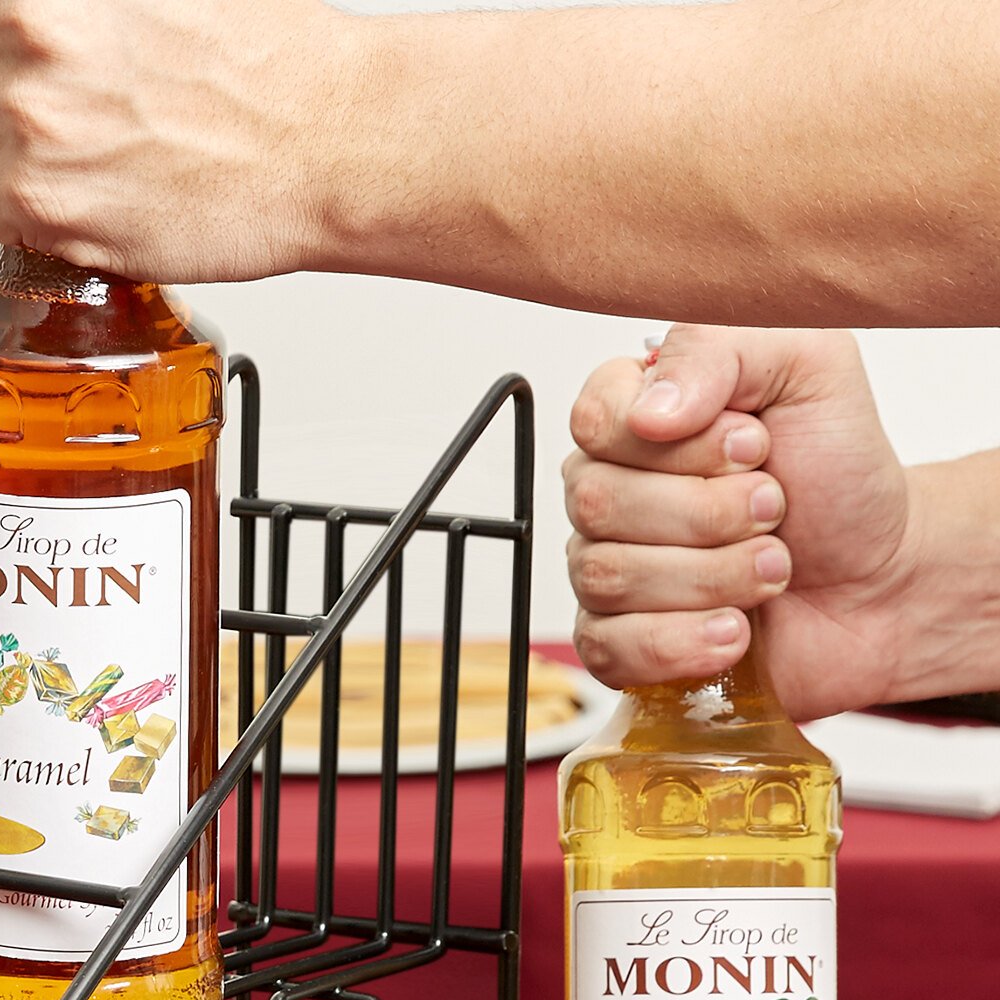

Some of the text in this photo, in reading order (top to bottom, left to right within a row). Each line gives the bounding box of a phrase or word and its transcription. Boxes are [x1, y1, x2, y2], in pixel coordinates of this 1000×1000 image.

[82, 533, 118, 555] de
[157, 916, 173, 931] oz
[626, 909, 798, 953] Le Sirop de
